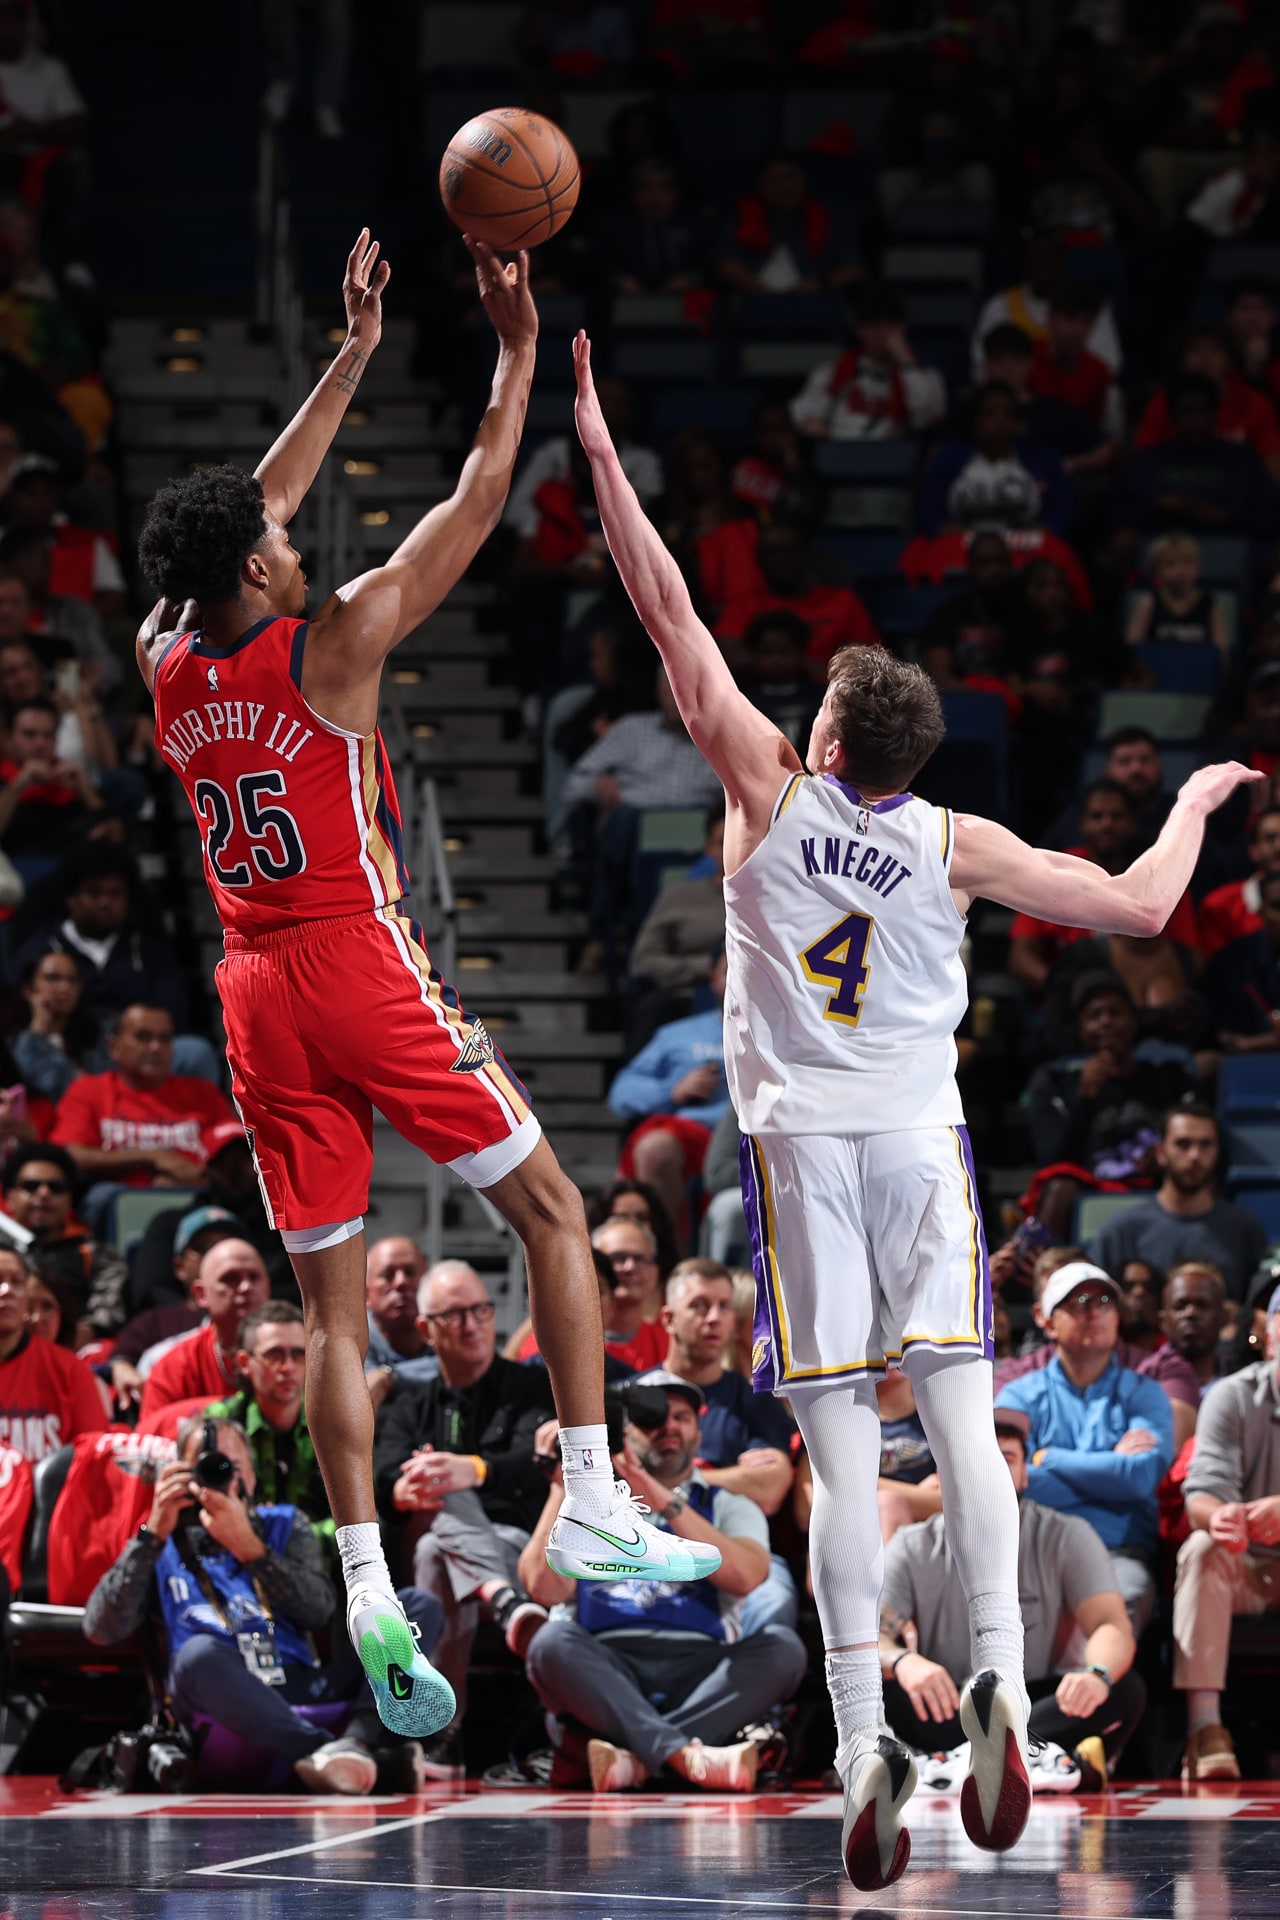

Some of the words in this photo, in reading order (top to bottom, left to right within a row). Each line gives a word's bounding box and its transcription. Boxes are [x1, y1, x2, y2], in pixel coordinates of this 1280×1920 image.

[162, 700, 265, 773] MURPHY
[264, 711, 314, 763] III
[194, 769, 307, 888] 25
[800, 836, 913, 899] KNECHT
[797, 910, 875, 1028] 4
